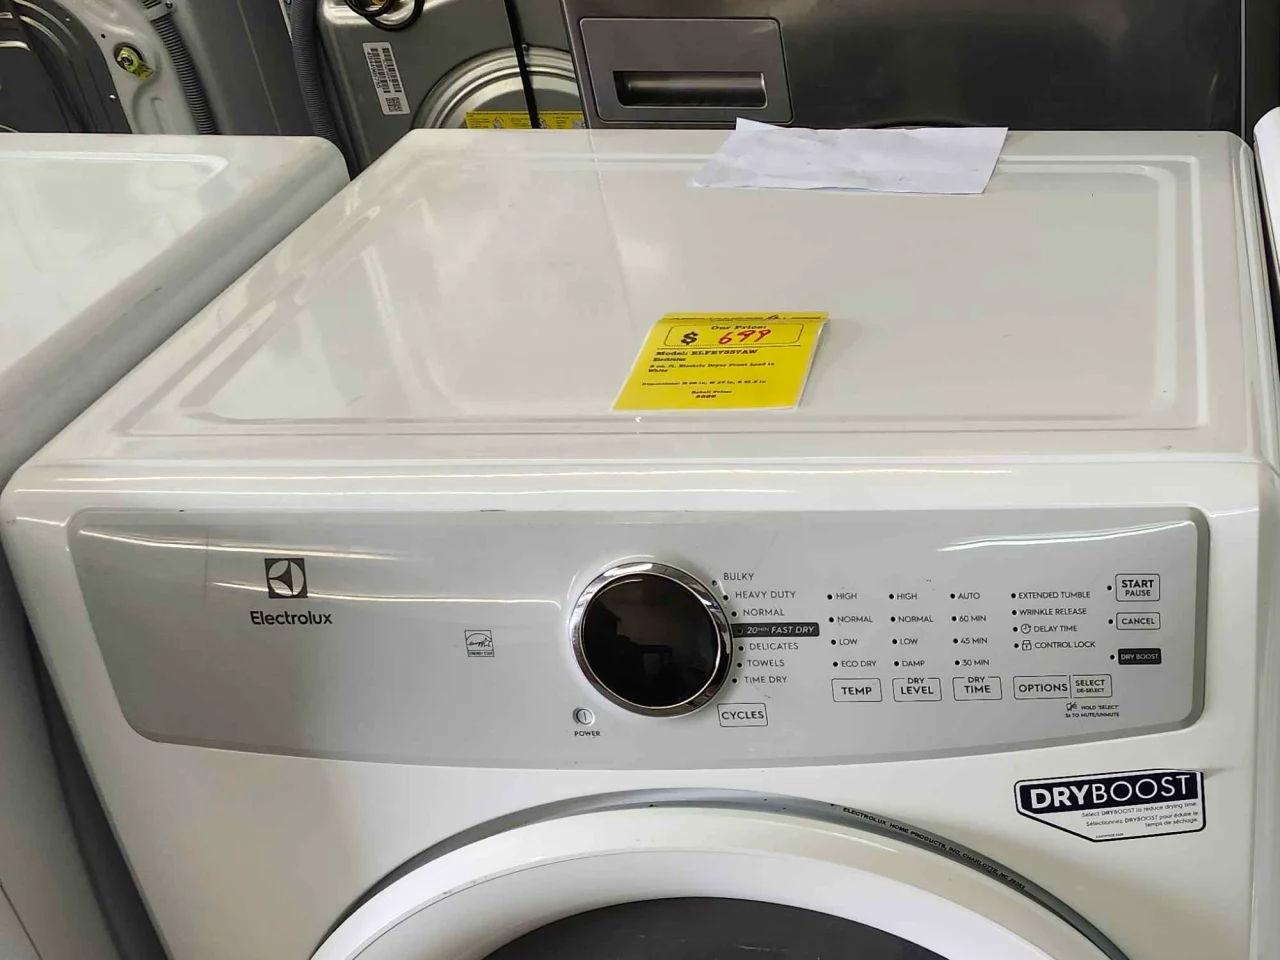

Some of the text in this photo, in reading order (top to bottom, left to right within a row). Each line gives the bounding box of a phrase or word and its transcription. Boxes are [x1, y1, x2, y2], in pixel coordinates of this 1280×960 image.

[680, 329, 772, 345] $ 699
[723, 573, 754, 581] BULKY
[1121, 580, 1154, 588] START
[250, 610, 333, 625] Electrolux
[743, 609, 785, 617] NORMAL
[795, 626, 814, 634] DRY
[750, 642, 798, 650] DELICATES
[841, 687, 872, 695] TEMP
[901, 686, 934, 695] LEVEL
[964, 685, 991, 694] TIME
[1018, 683, 1068, 693] OPTIONS
[721, 711, 765, 720] CYCLES
[1030, 775, 1190, 809] DRYBOOST
[1125, 815, 1158, 823] DRYBOOST
[843, 807, 887, 825] ELECTROLUX
[889, 822, 909, 834] HOME
[910, 831, 947, 850] PRODUCTS,
